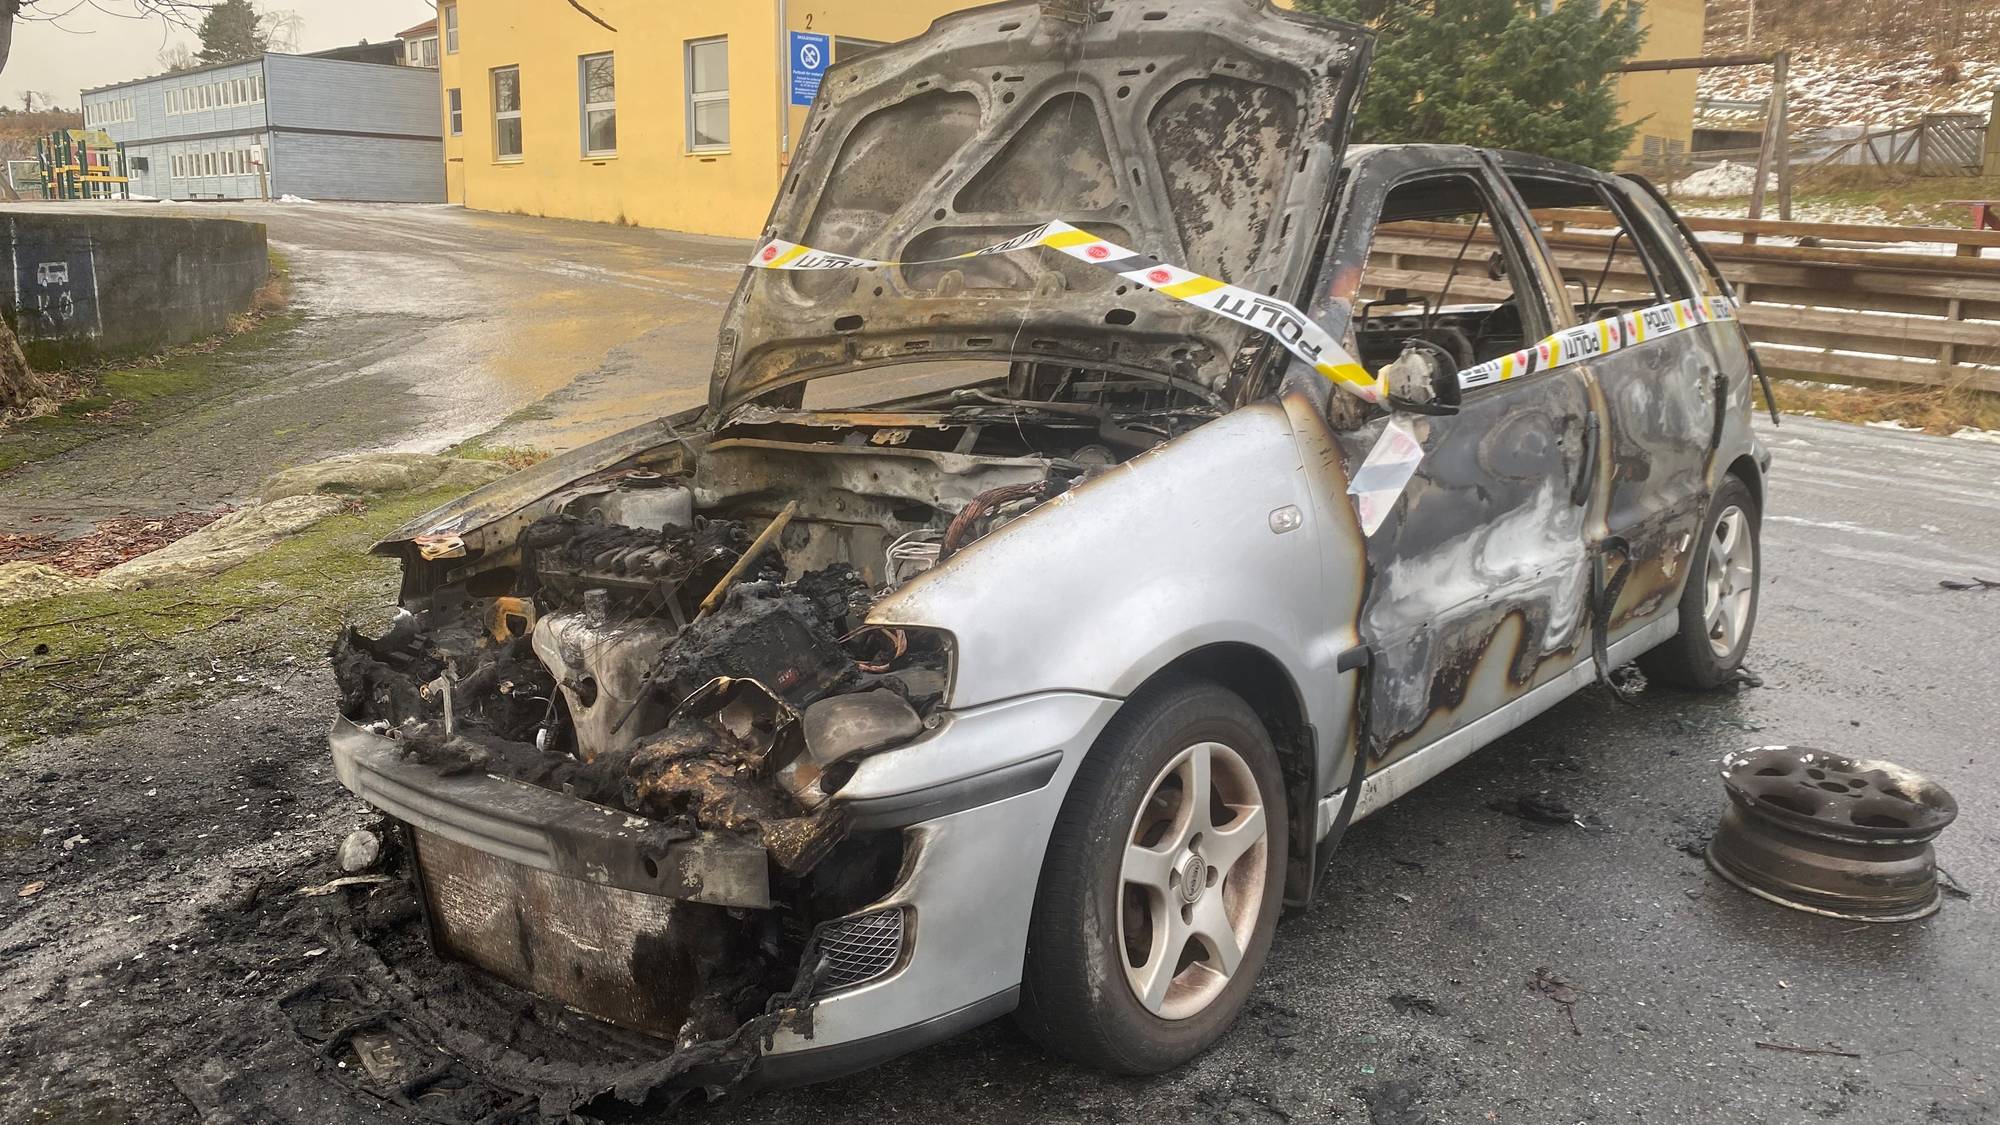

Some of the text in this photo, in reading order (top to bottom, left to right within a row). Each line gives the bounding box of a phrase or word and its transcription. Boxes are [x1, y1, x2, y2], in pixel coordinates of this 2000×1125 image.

[806, 14, 813, 30] 2
[1214, 294, 1322, 362] POLITI
[1644, 307, 1677, 330] POLITI
[1563, 334, 1600, 359] POLITI
